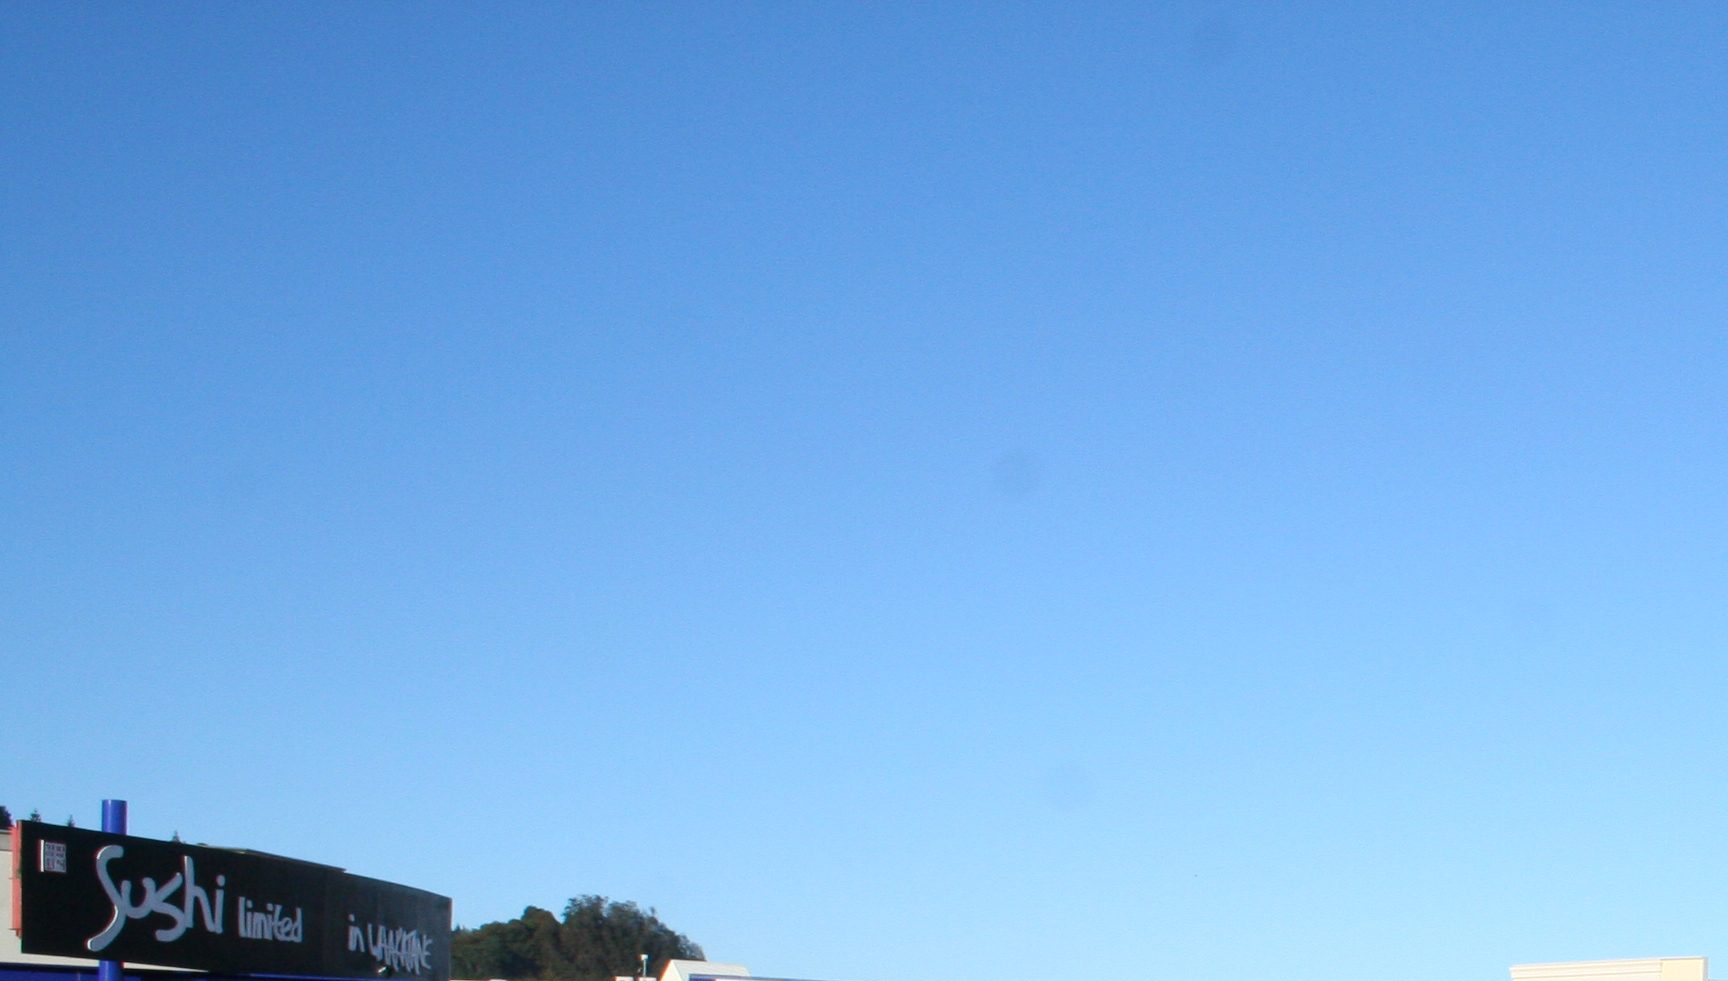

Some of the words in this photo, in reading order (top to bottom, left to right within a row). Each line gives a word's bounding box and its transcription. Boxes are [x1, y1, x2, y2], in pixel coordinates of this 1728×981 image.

[85, 844, 225, 952] Sushi
[237, 896, 304, 944] limited
[348, 913, 366, 953] in
